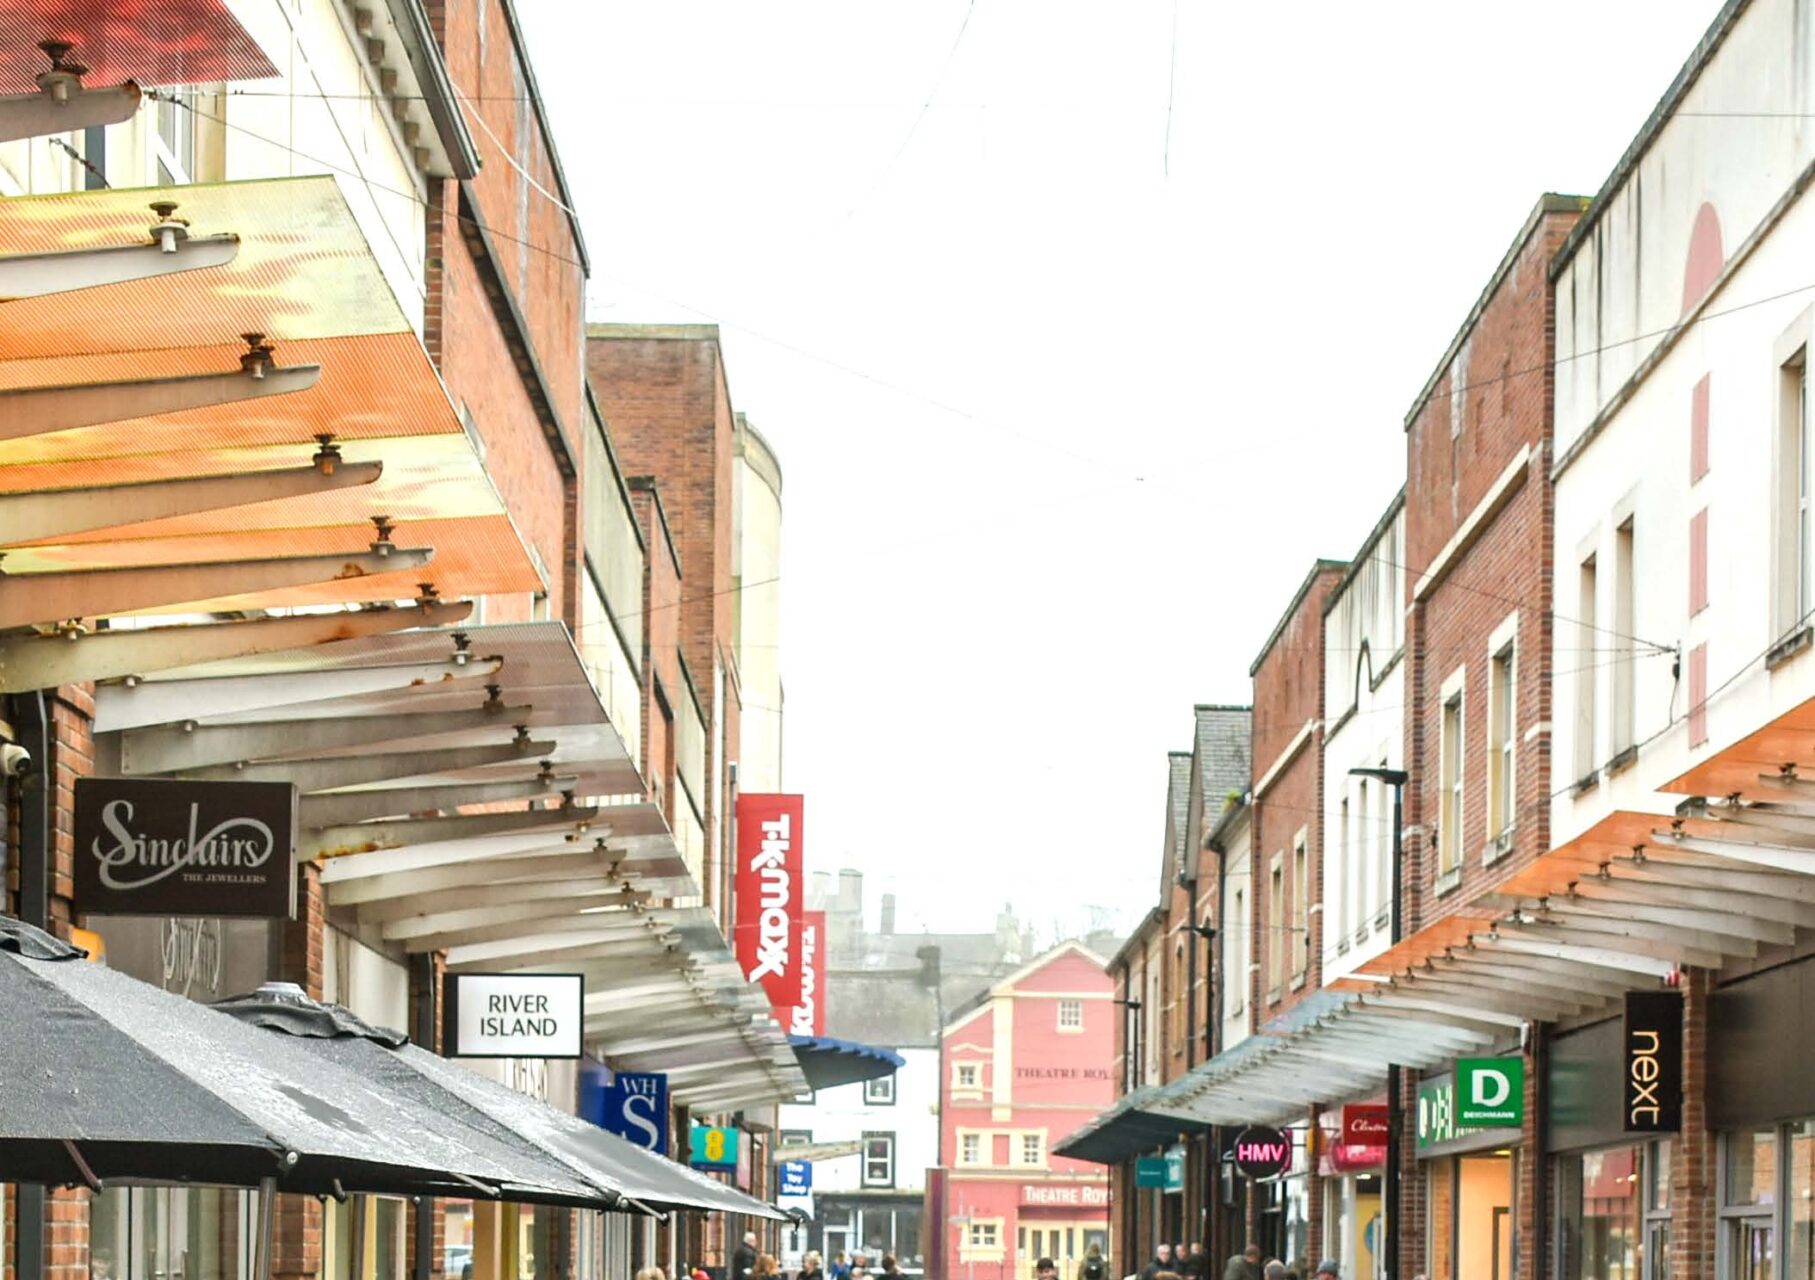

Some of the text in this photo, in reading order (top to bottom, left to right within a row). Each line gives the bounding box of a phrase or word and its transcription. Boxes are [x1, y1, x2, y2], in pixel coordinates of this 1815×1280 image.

[92, 800, 274, 890] Sinclairs
[182, 873, 267, 884] THE JEWELLERS
[488, 994, 549, 1014] RIVER
[480, 1017, 558, 1037] ISLAND
[1015, 1067, 1113, 1080] THEATRE ROY
[1630, 1030, 1660, 1125] next
[621, 1077, 658, 1095] WH
[1471, 1068, 1510, 1107] D
[621, 1094, 659, 1151] S
[1237, 1143, 1284, 1163] HMV
